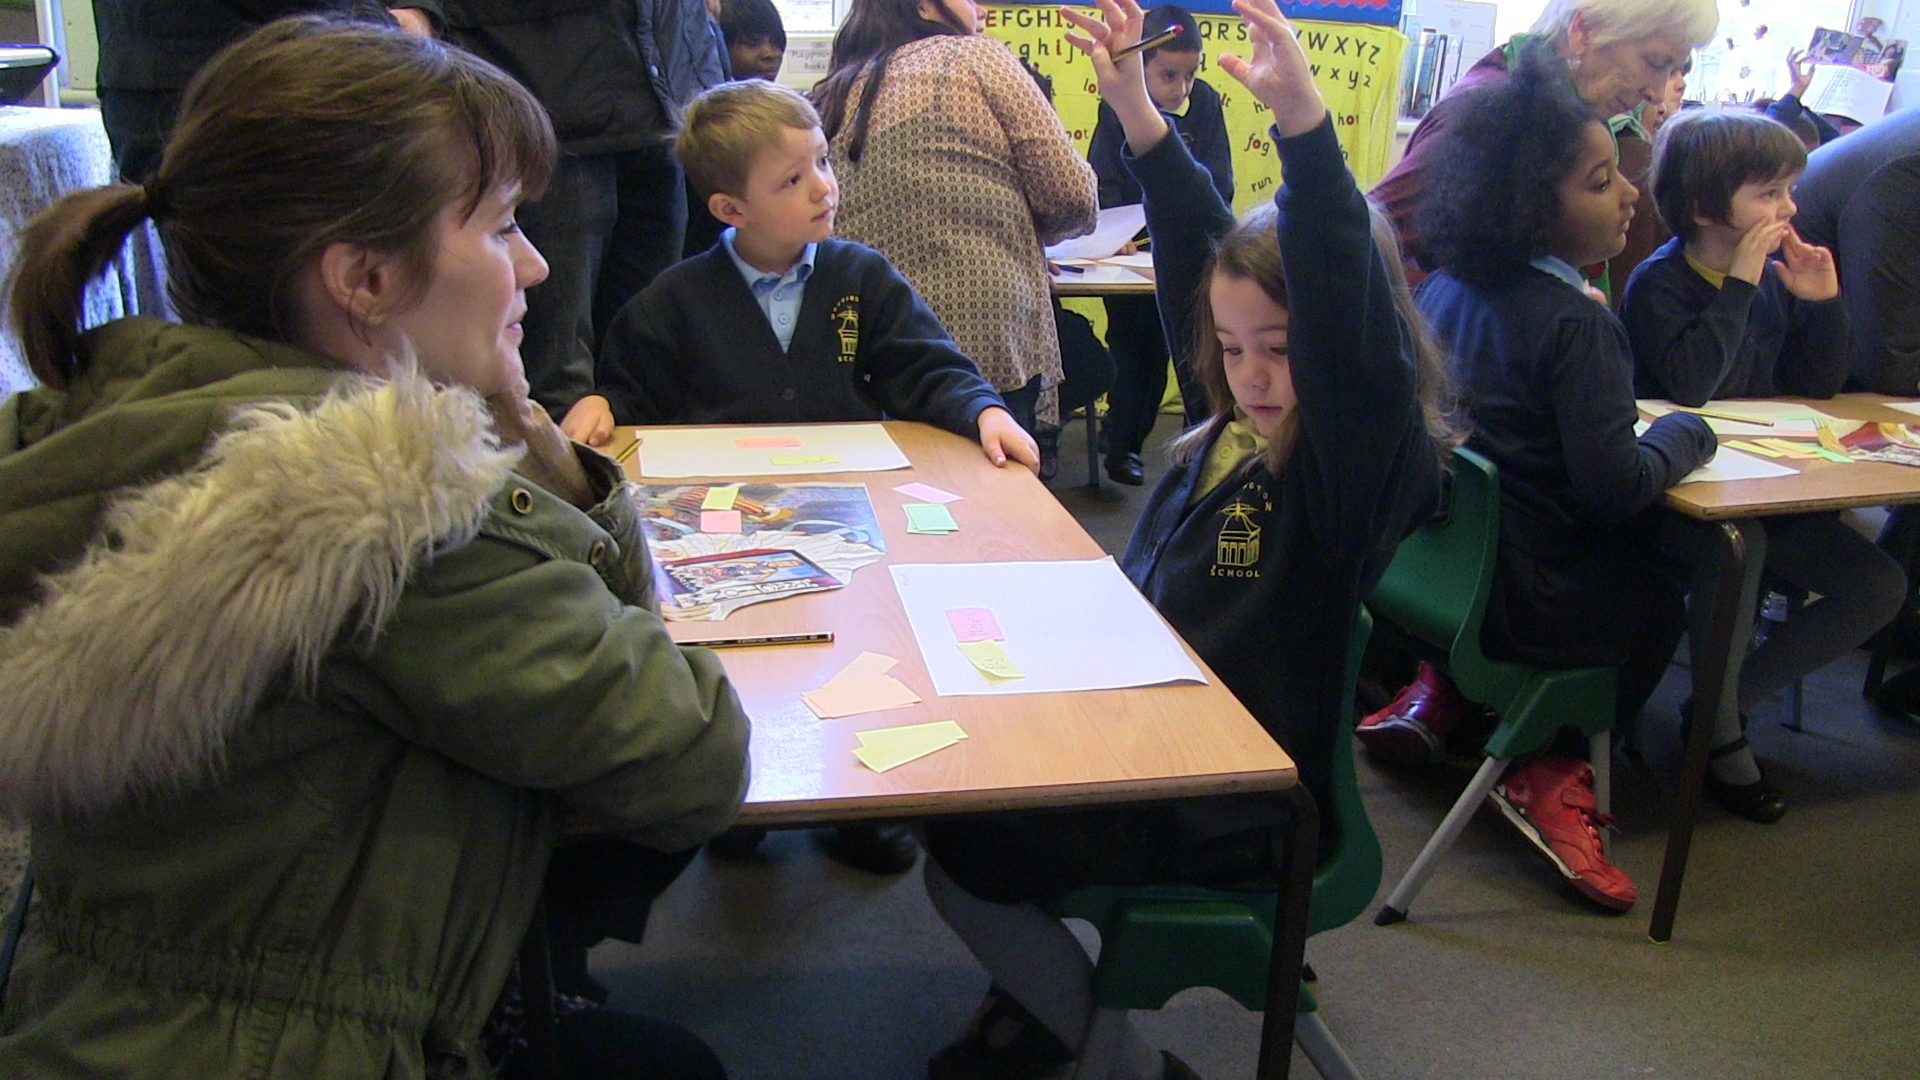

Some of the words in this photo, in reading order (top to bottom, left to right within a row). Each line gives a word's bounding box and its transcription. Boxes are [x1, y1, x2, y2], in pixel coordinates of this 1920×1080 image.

[1337, 111, 1360, 127] hot
[1243, 132, 1271, 157] fog
[1250, 176, 1273, 193] run
[1209, 567, 1261, 579] SCHOOL
